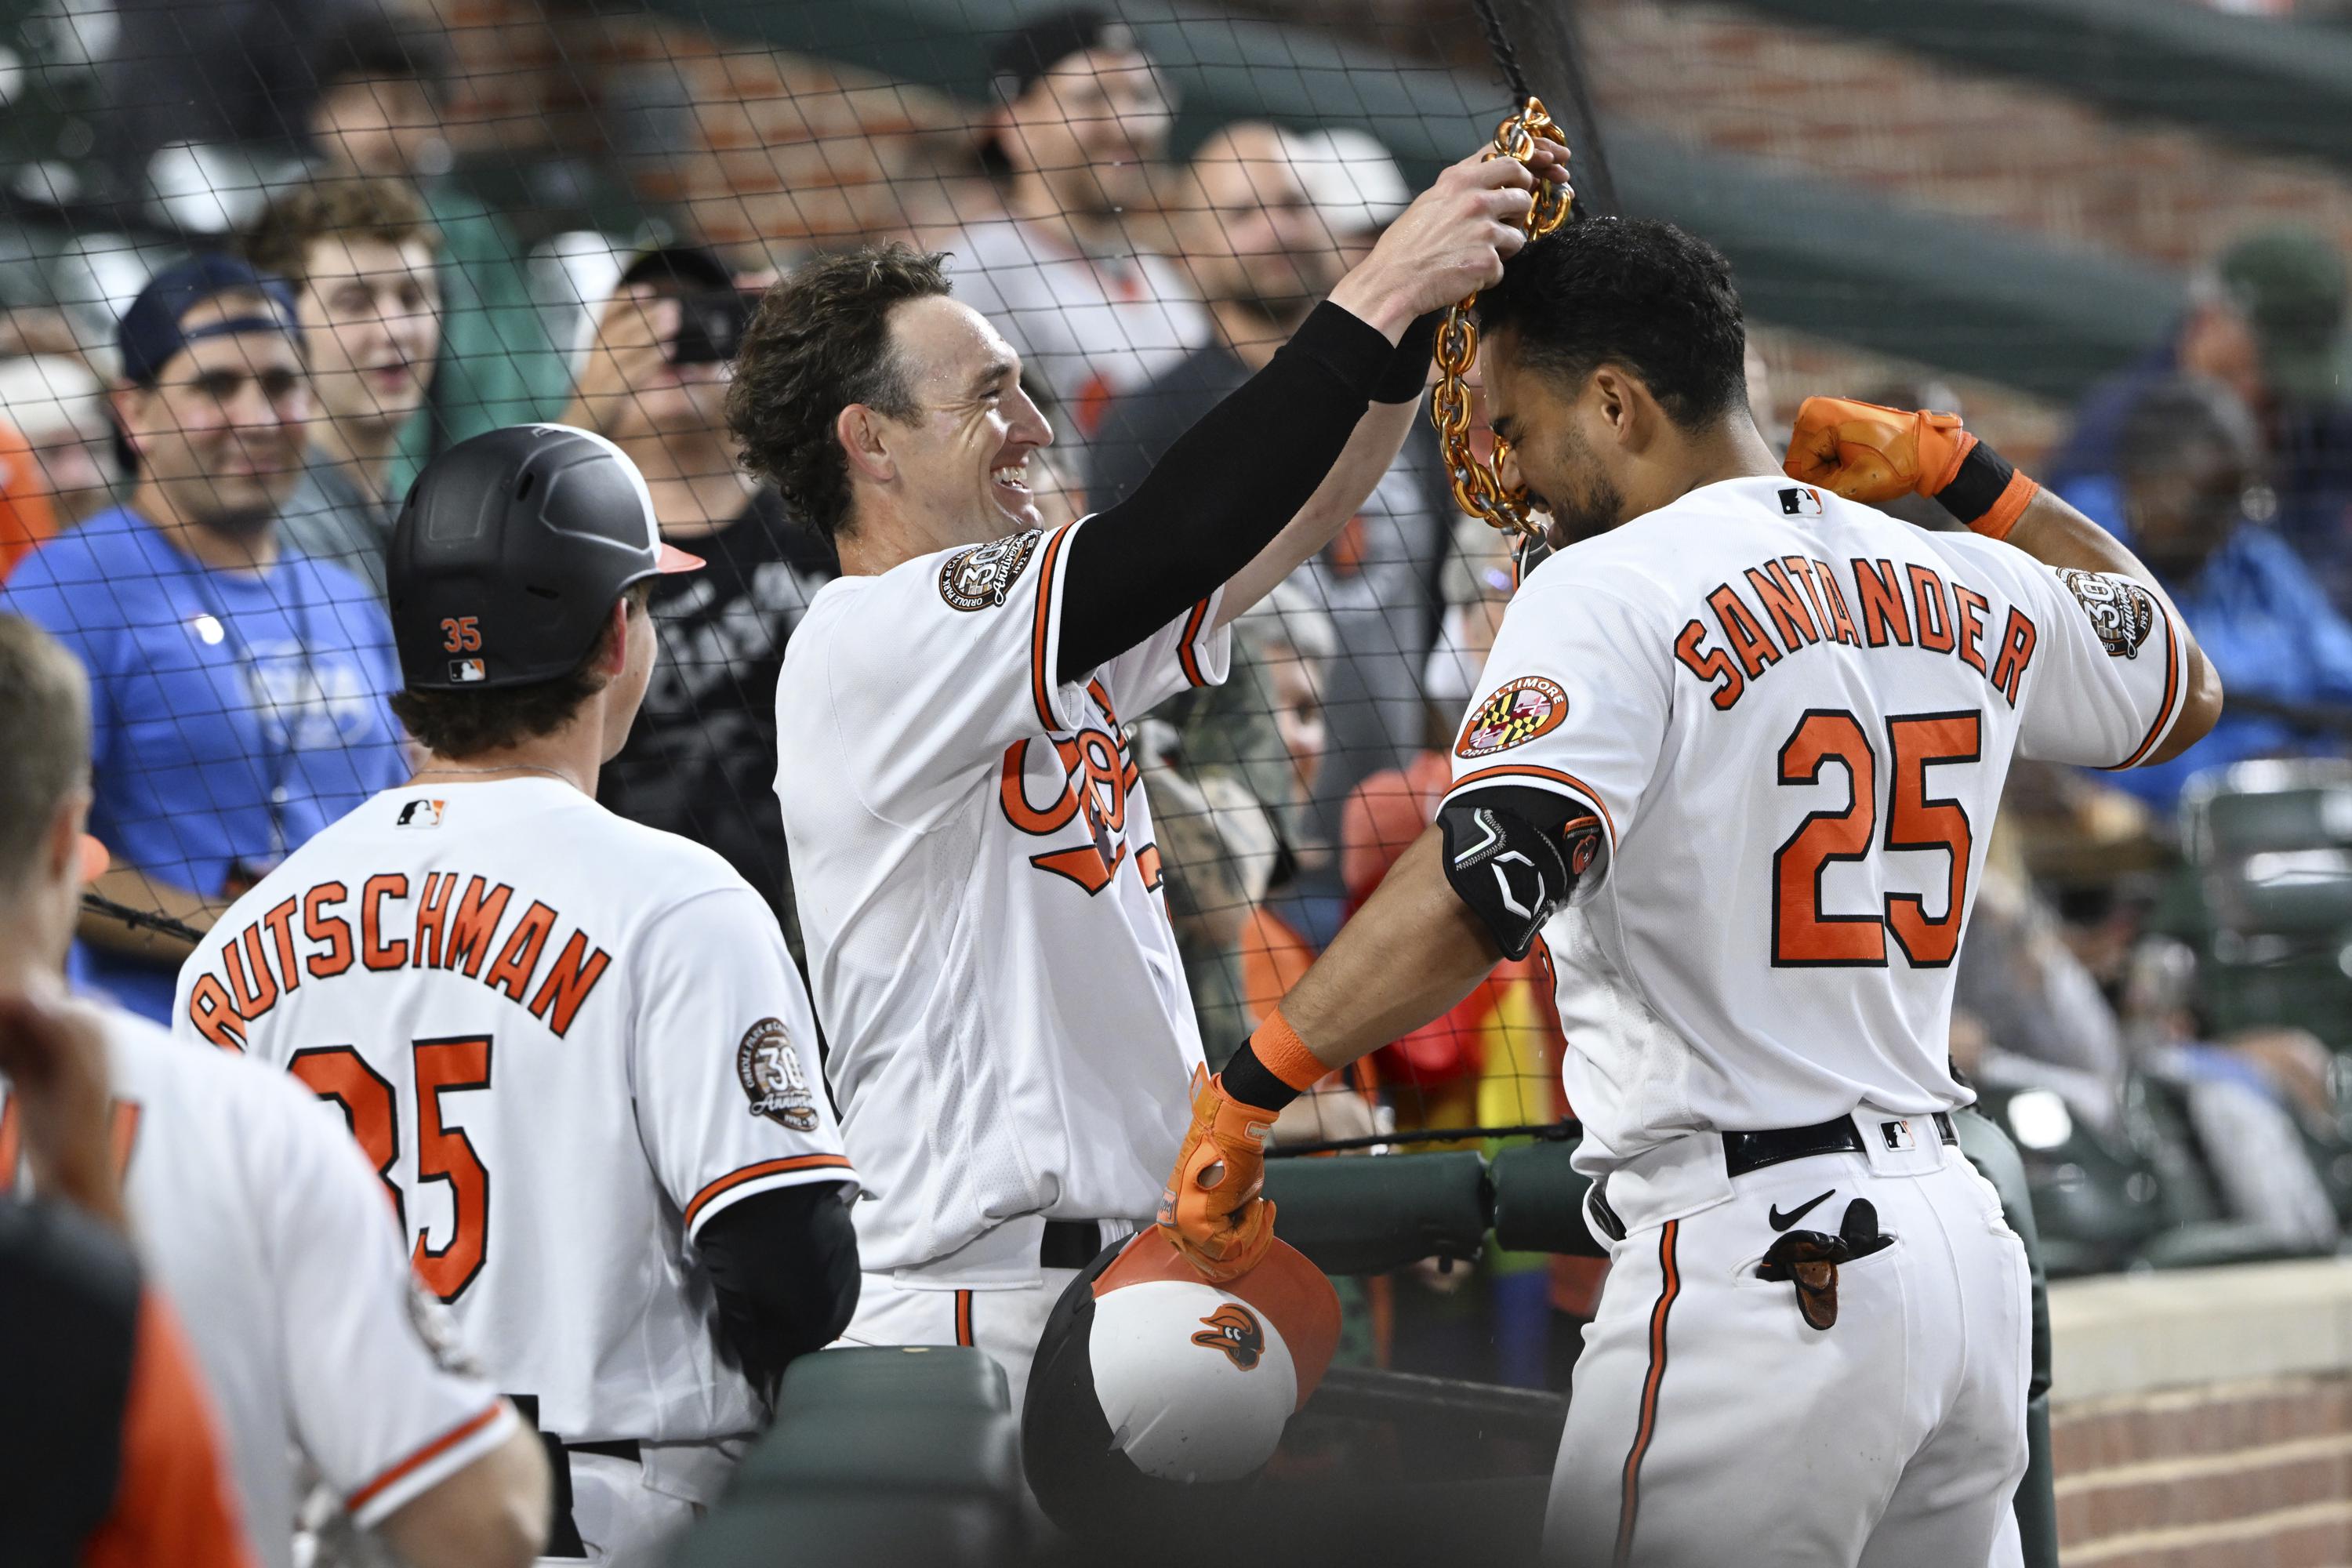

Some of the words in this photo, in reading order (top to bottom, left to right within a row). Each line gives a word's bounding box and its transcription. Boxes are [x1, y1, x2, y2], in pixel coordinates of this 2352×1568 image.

[959, 544, 1008, 590] 30
[993, 528, 1043, 605] Anniversary
[1013, 556, 1027, 574] 1992
[942, 580, 954, 598] PARK
[953, 597, 982, 607] ORIOLE
[2077, 579, 2121, 630] 30
[441, 616, 481, 652] 35
[1674, 555, 2037, 710] SANTANDER
[2140, 610, 2148, 630] 1992
[1472, 678, 1564, 721] BALTIMORE
[1461, 735, 1534, 756] ORIOLES
[1771, 709, 1981, 968] 25
[190, 872, 612, 1054] RUTSCHMAN
[757, 1046, 804, 1091] 30
